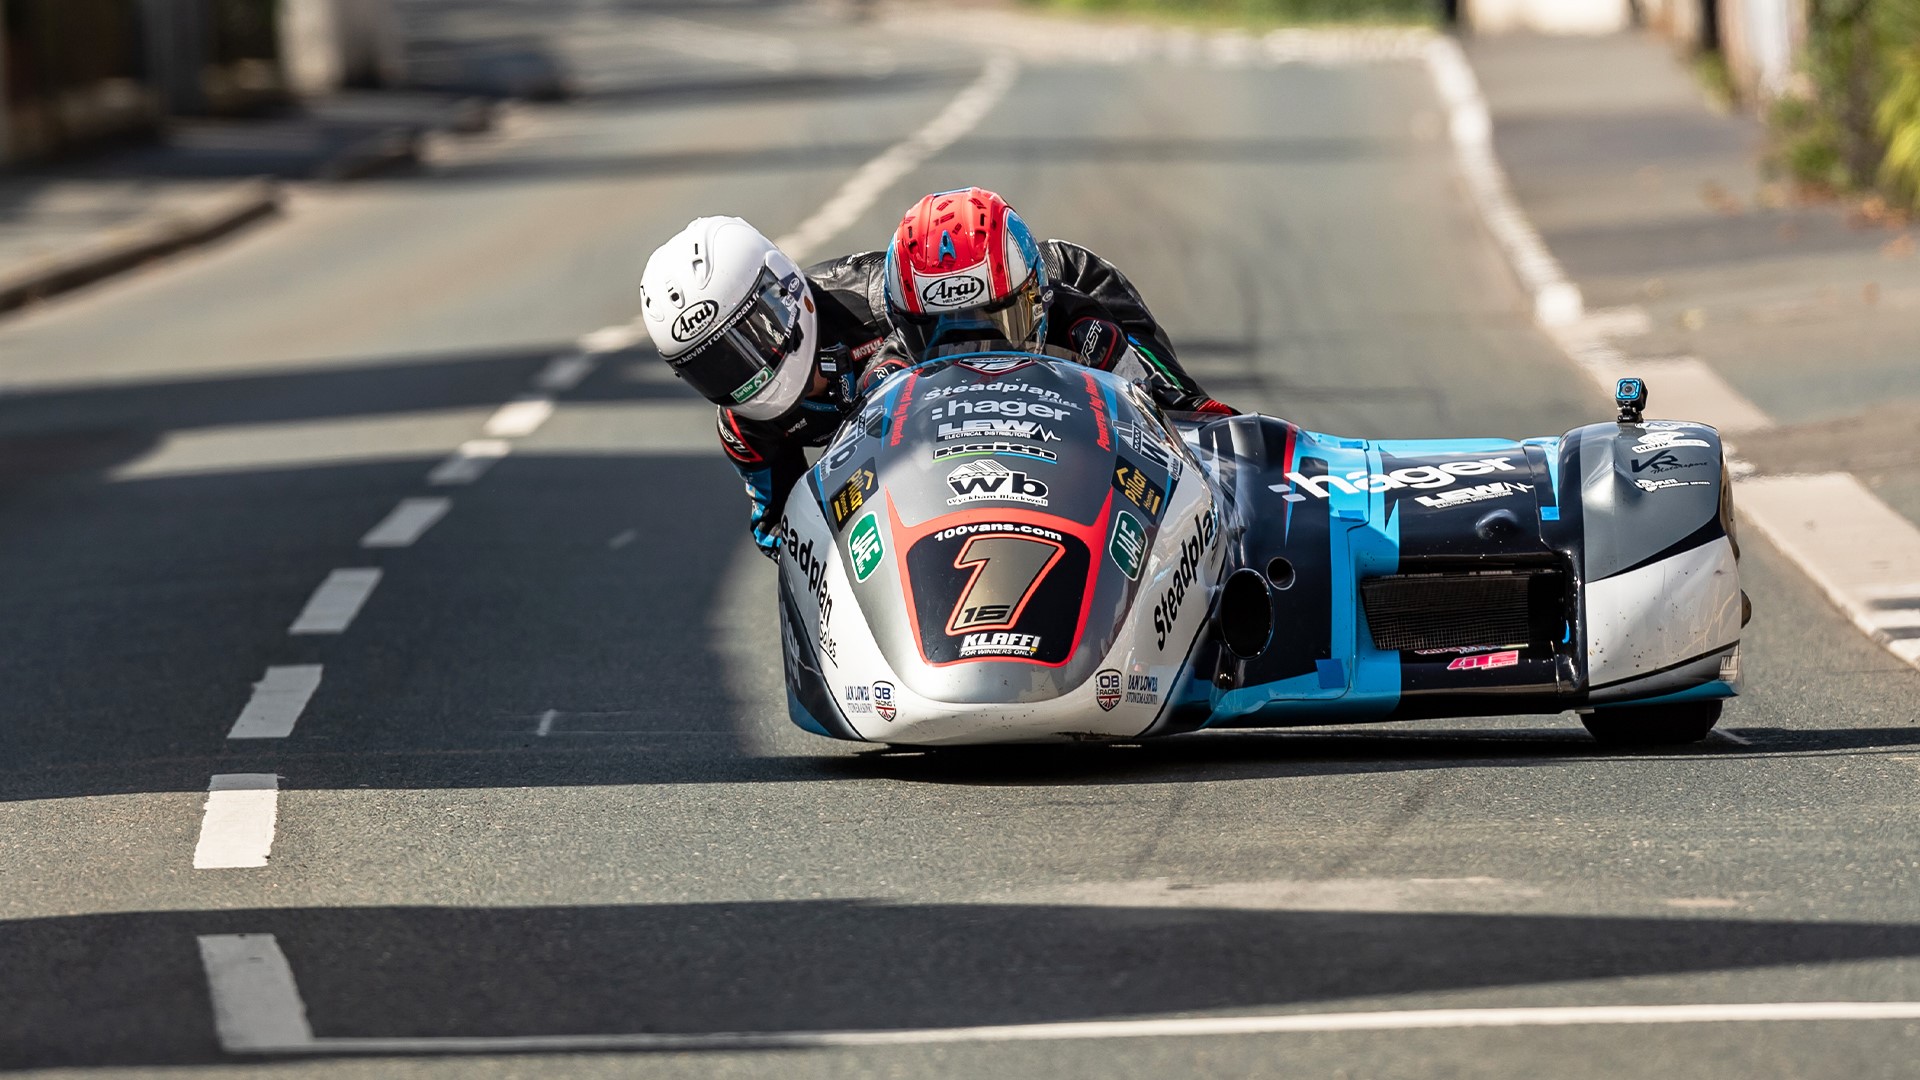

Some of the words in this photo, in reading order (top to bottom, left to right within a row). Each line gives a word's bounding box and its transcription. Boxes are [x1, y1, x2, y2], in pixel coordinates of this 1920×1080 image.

[932, 277, 978, 300] Arai
[678, 302, 713, 337] Arai
[1081, 320, 1103, 367] RST
[924, 381, 1061, 401] Steadplan
[937, 419, 1037, 438] LEW
[944, 431, 983, 440] ELECTRICAL
[984, 431, 1031, 440] DISTRIBUTORS
[846, 468, 864, 513] Pillar
[1124, 466, 1148, 508] Pillar
[1415, 481, 1504, 507] LEW
[948, 494, 997, 505] Wyckham
[1000, 494, 1048, 506] Blackwell
[933, 523, 1063, 542] 100vans.com
[852, 526, 880, 568] JAF
[1116, 520, 1142, 570] JAF
[780, 513, 833, 627] eadplan
[945, 533, 1066, 636] 1
[960, 649, 976, 658] FOR
[977, 648, 1013, 656] WINNERS
[1013, 648, 1035, 657] ONLY
[1100, 675, 1119, 689] OB
[1100, 688, 1120, 696] RACING
[1140, 675, 1158, 693] LOWES
[874, 686, 891, 700] OB
